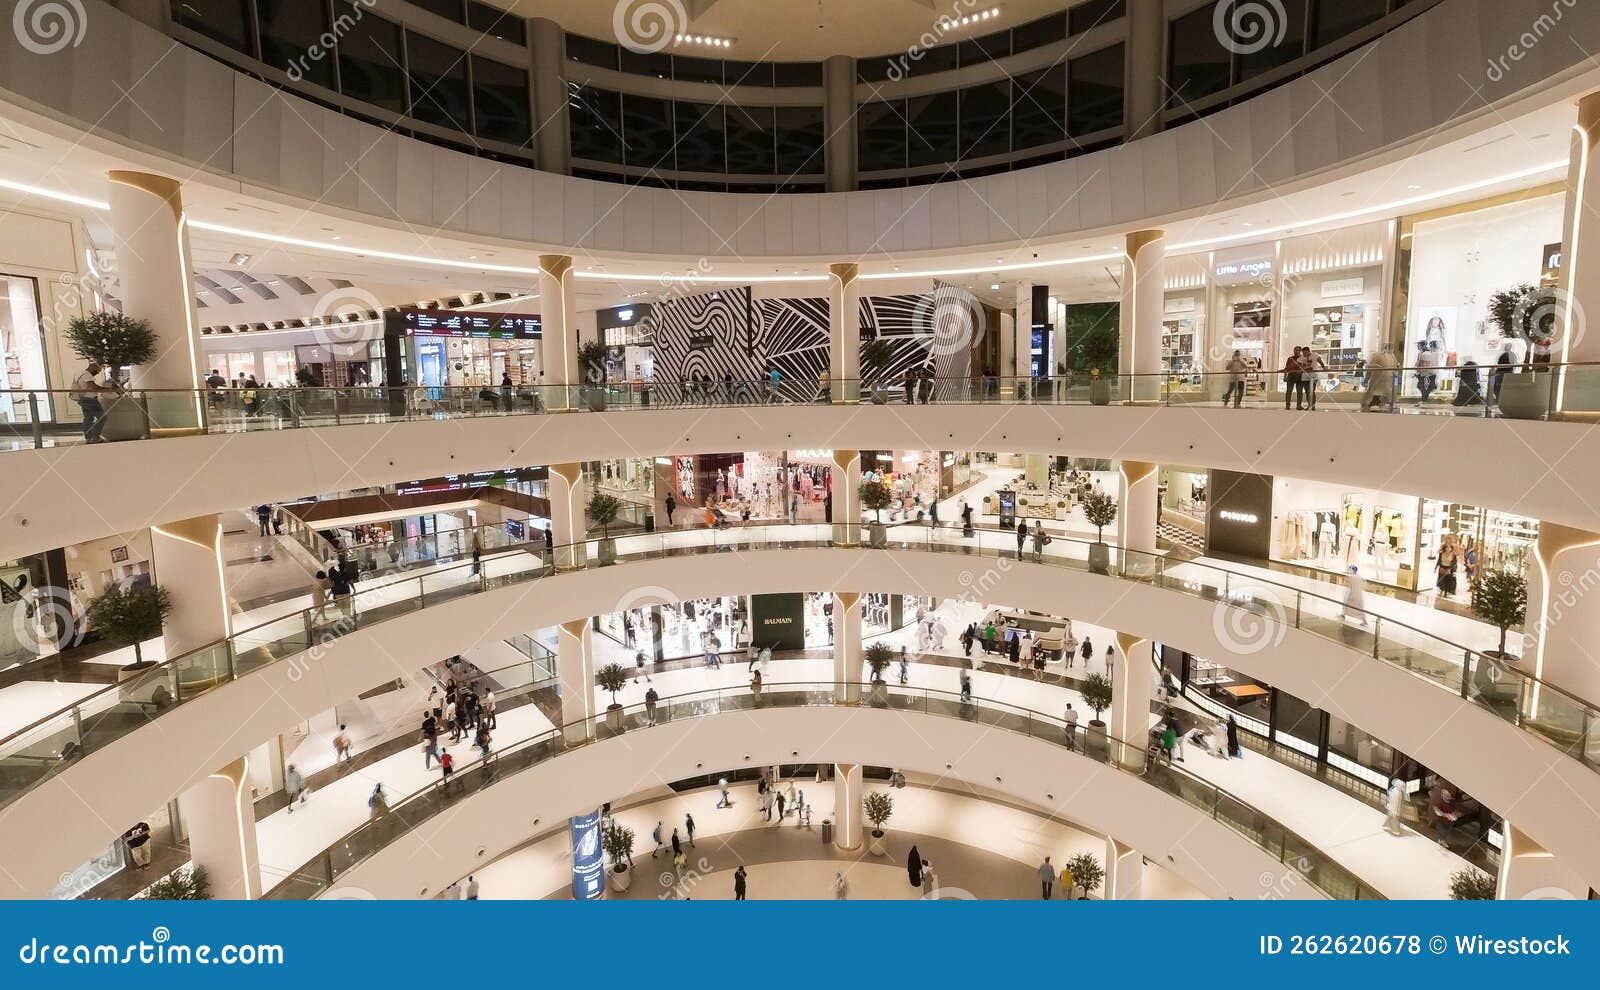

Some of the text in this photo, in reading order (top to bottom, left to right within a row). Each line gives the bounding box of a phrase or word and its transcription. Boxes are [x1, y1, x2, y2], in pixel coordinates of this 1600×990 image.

[1215, 260, 1271, 276] Little Angels
[1220, 510, 1257, 523] PINKO
[764, 617, 792, 625] BALMAIN
